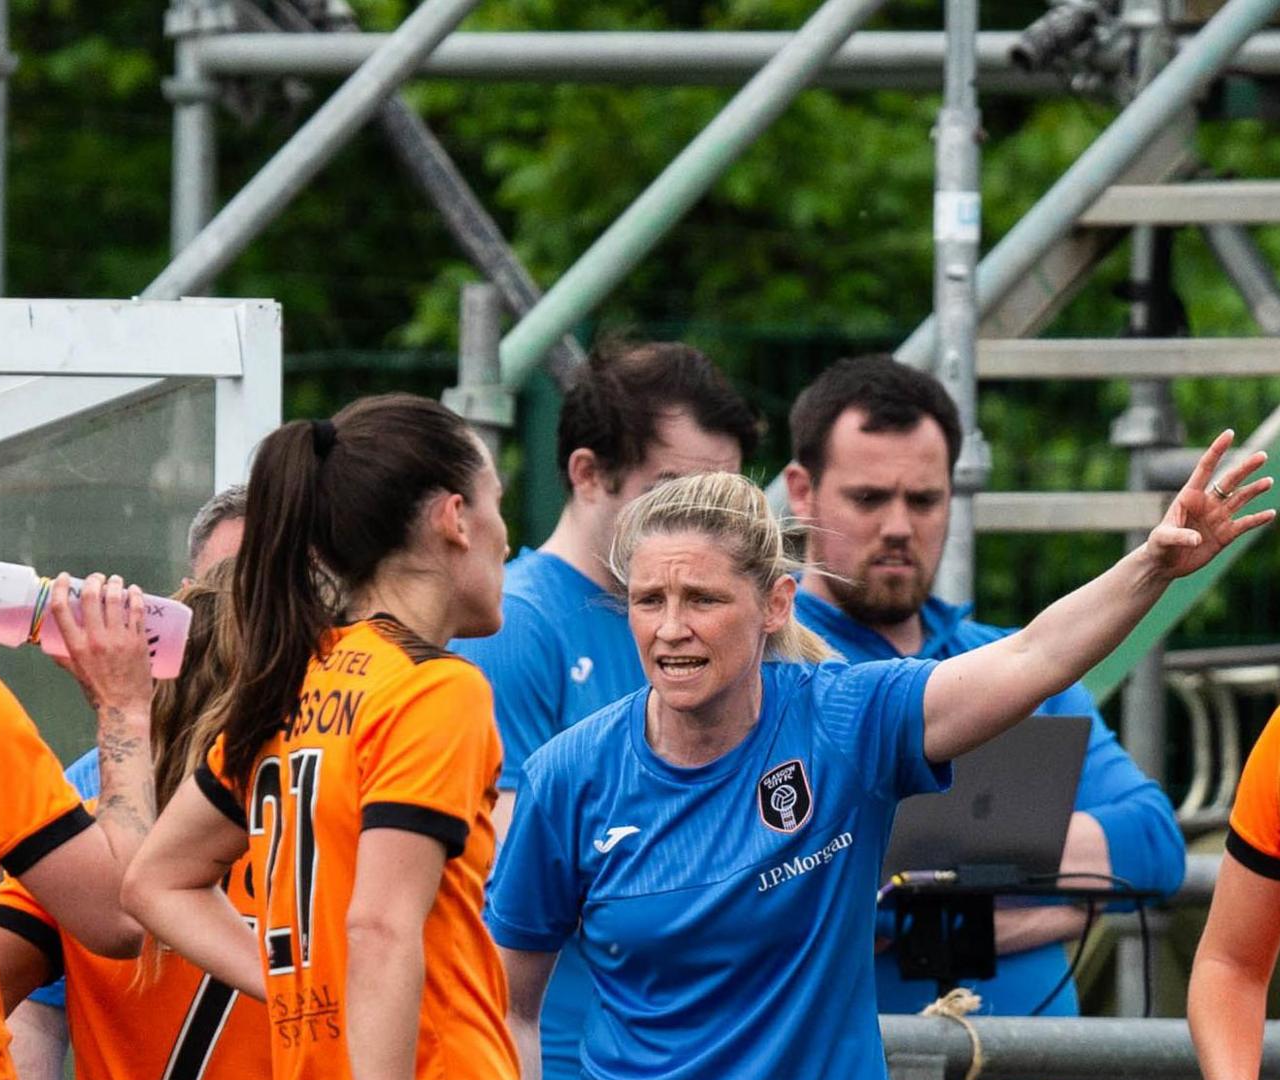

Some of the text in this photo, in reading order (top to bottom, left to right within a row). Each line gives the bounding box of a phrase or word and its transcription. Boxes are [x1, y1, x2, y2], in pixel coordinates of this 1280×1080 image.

[310, 650, 373, 676] OTEL
[249, 748, 324, 976] 21
[757, 831, 854, 892] J.P.Morgan
